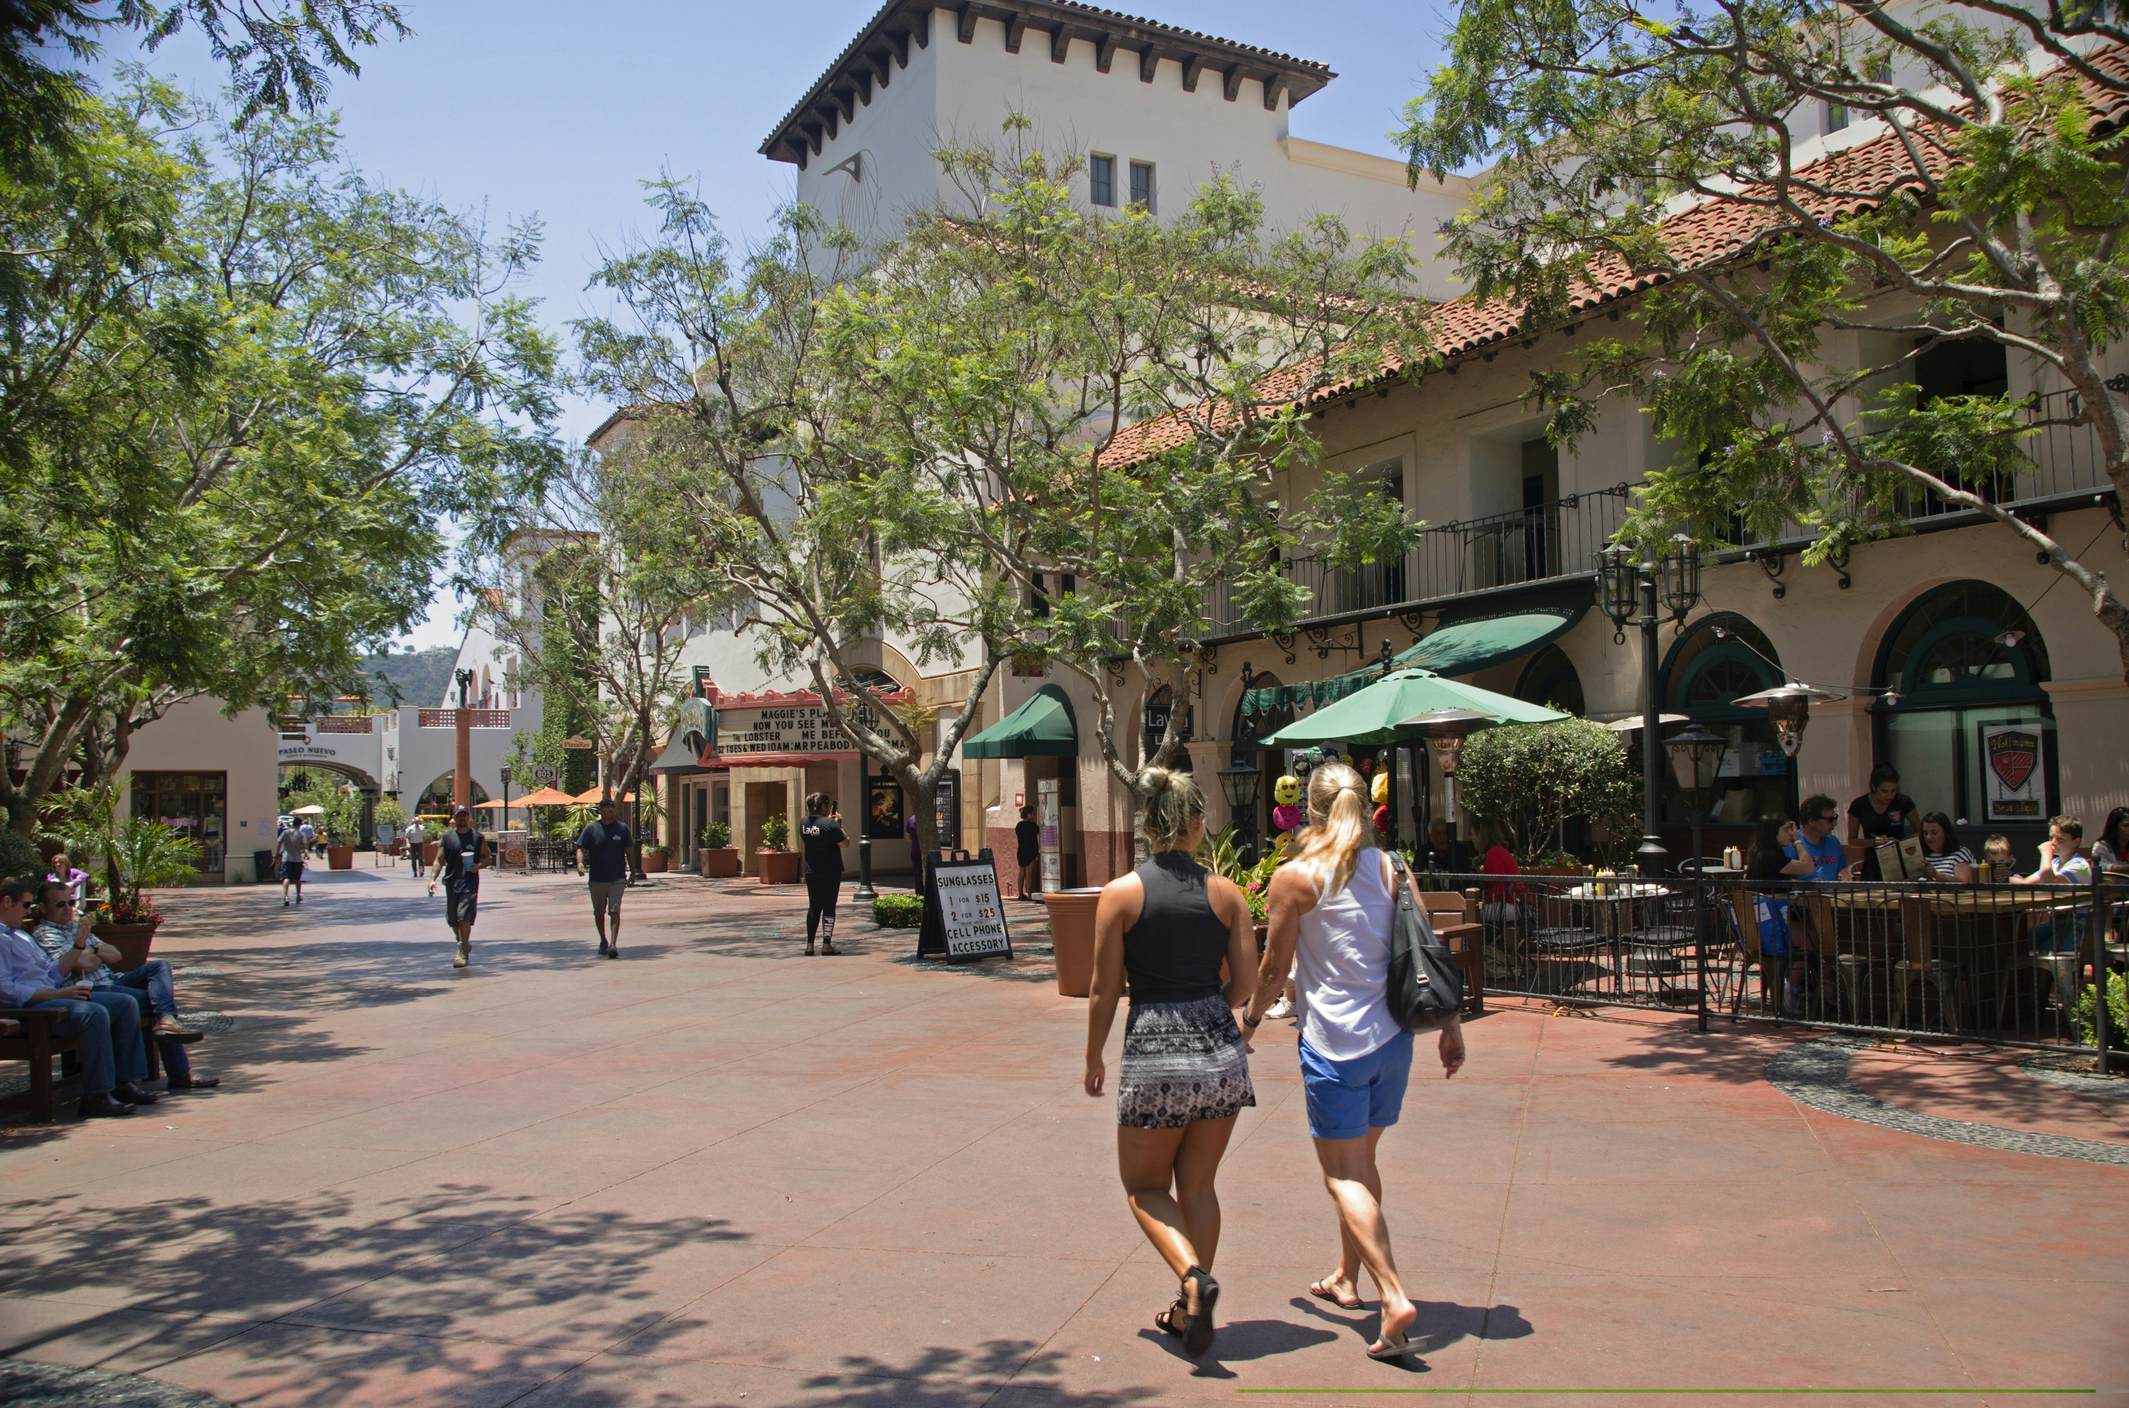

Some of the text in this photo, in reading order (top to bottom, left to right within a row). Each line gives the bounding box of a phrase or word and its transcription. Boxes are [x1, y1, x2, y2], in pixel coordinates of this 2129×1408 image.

[761, 708, 830, 720] MAGGIE'S PLA
[753, 721, 771, 731] NOW
[775, 720, 794, 730] YOU
[798, 719, 816, 729] SEE
[744, 731, 781, 742] LOBSTER
[801, 730, 816, 740] ME
[307, 747, 336, 756] NUEVO
[750, 743, 766, 753] WED
[938, 874, 994, 887] SUNGLASSES
[949, 896, 953, 905] 1
[976, 894, 989, 903] $15
[951, 911, 957, 921] 2
[979, 908, 995, 918] $25
[947, 923, 1002, 939] CELL PHONE
[953, 939, 1004, 952] ACCESSORY
